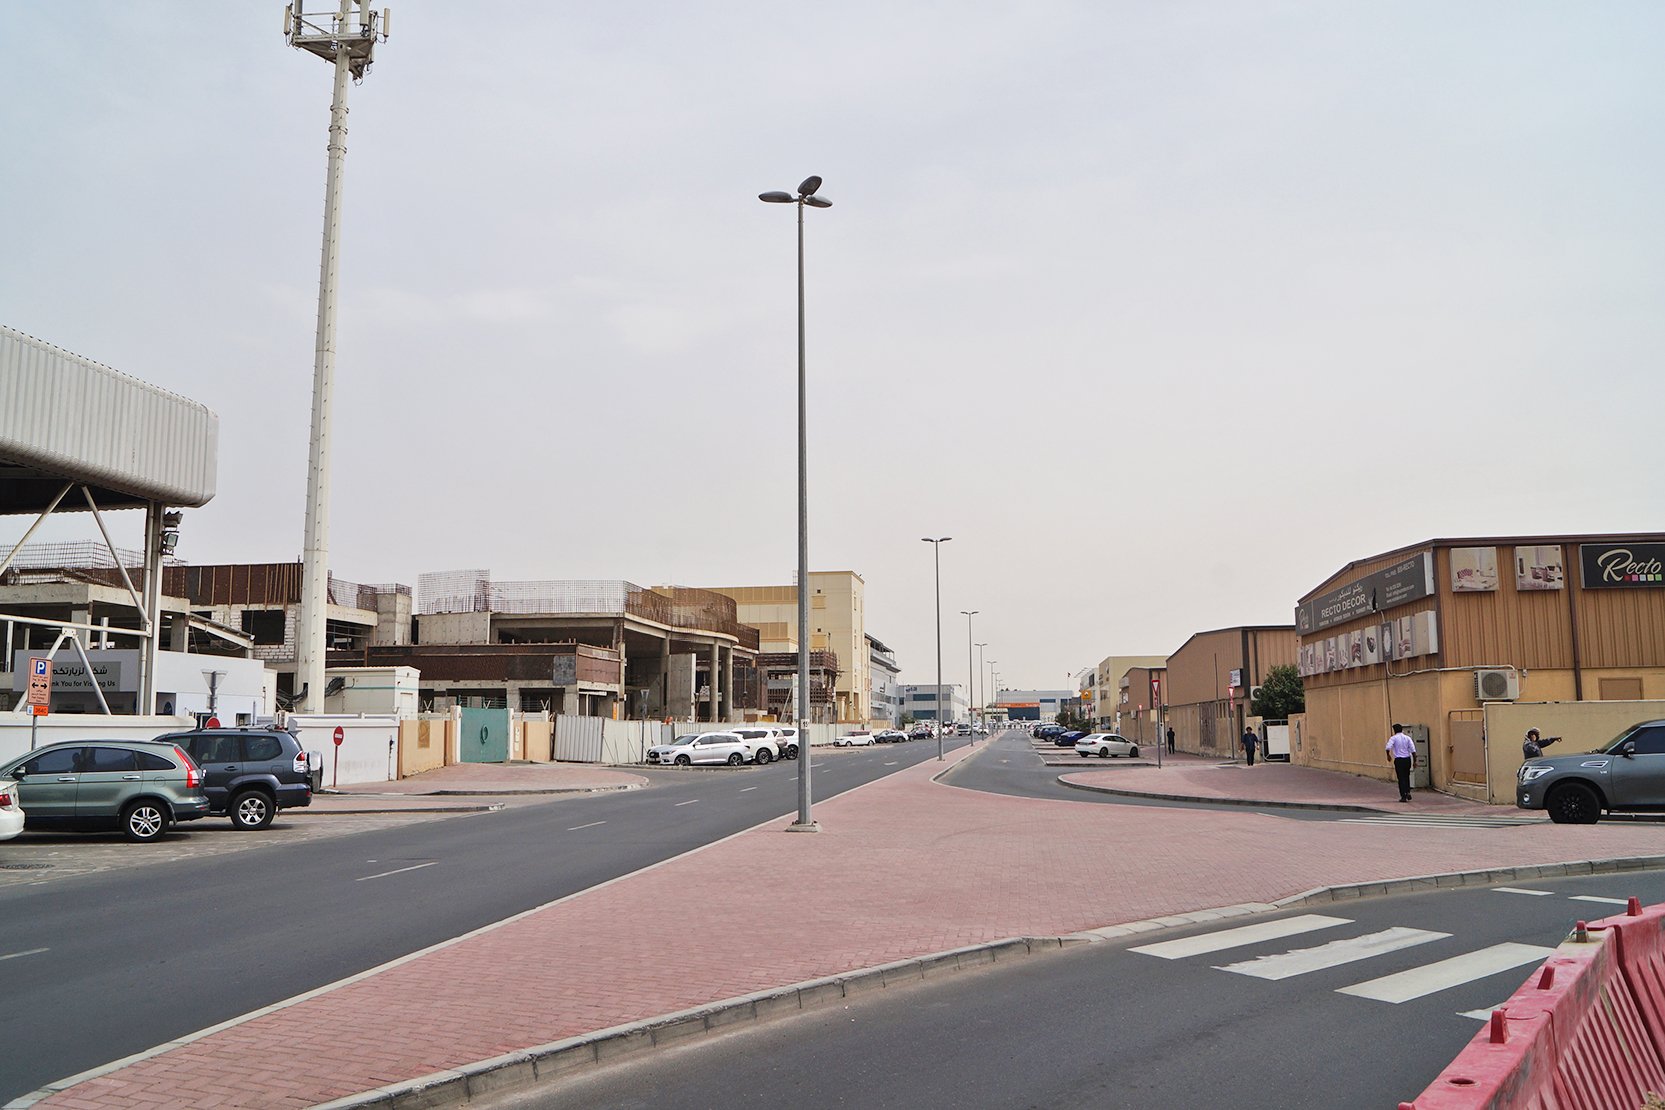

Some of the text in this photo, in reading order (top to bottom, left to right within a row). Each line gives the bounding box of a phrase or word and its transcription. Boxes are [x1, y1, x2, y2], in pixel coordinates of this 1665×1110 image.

[1597, 548, 1662, 582] Recto
[1321, 604, 1341, 619] RECTO
[1342, 593, 1366, 611] DECOR
[37, 661, 45, 674] P
[83, 680, 106, 688] Visng
